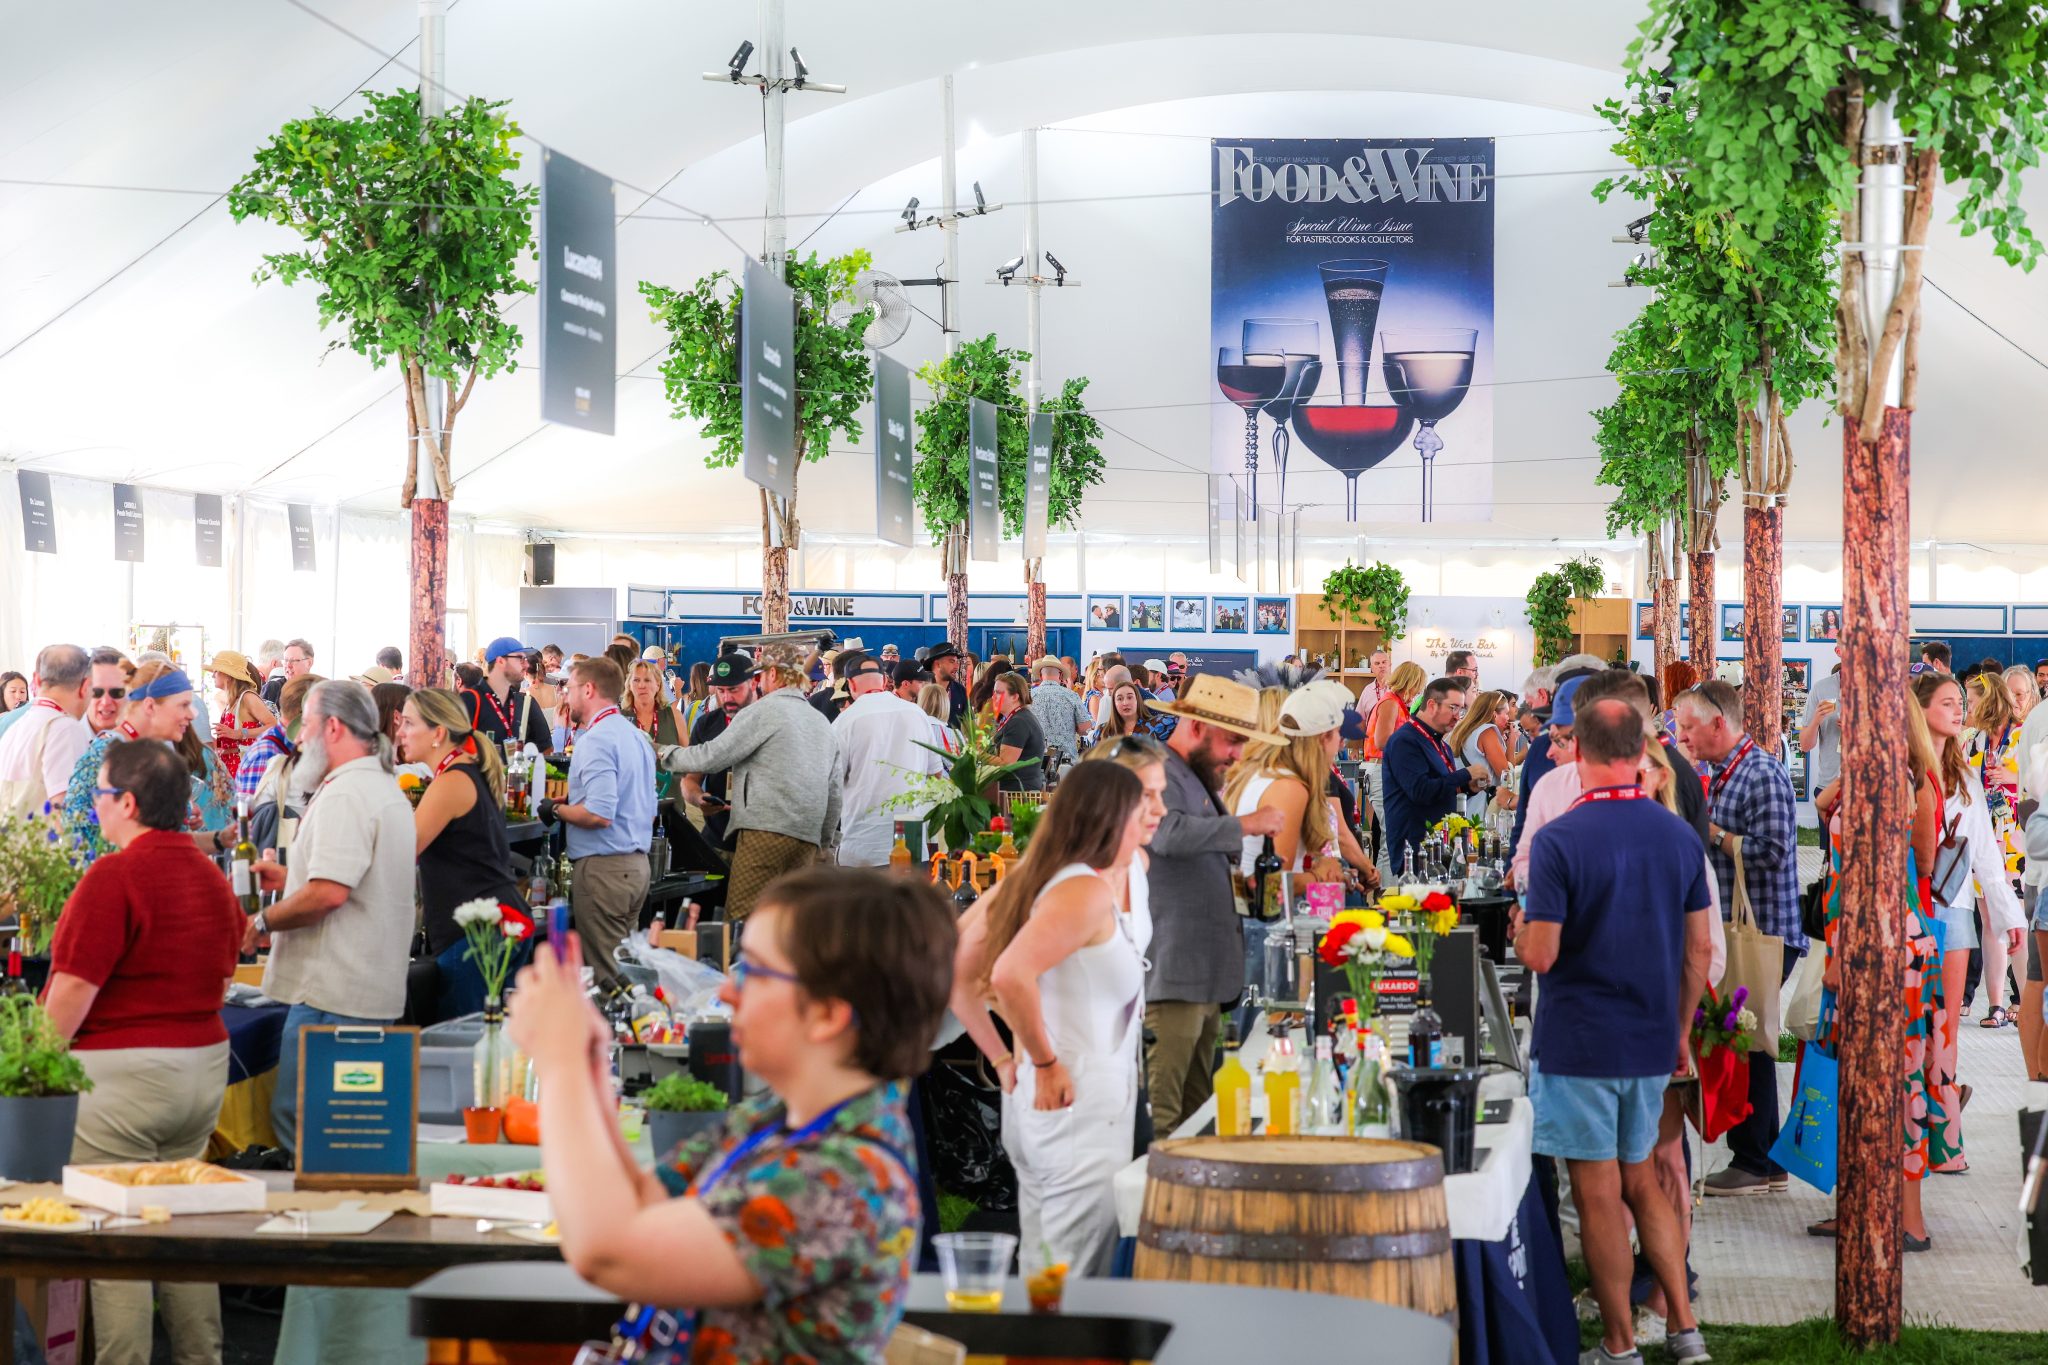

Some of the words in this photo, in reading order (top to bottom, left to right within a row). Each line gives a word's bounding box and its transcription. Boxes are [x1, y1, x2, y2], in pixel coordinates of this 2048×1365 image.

[1287, 217, 1337, 235] Special
[1338, 215, 1372, 232] Wine
[1374, 216, 1414, 233] Issue
[1286, 235, 1301, 243] FOR
[1332, 235, 1360, 243] COOKS
[1360, 235, 1367, 243] &
[1367, 235, 1414, 244] COLLECTORS
[1425, 637, 1447, 649] The
[1450, 637, 1474, 649] Wine
[1477, 638, 1498, 650] Bar
